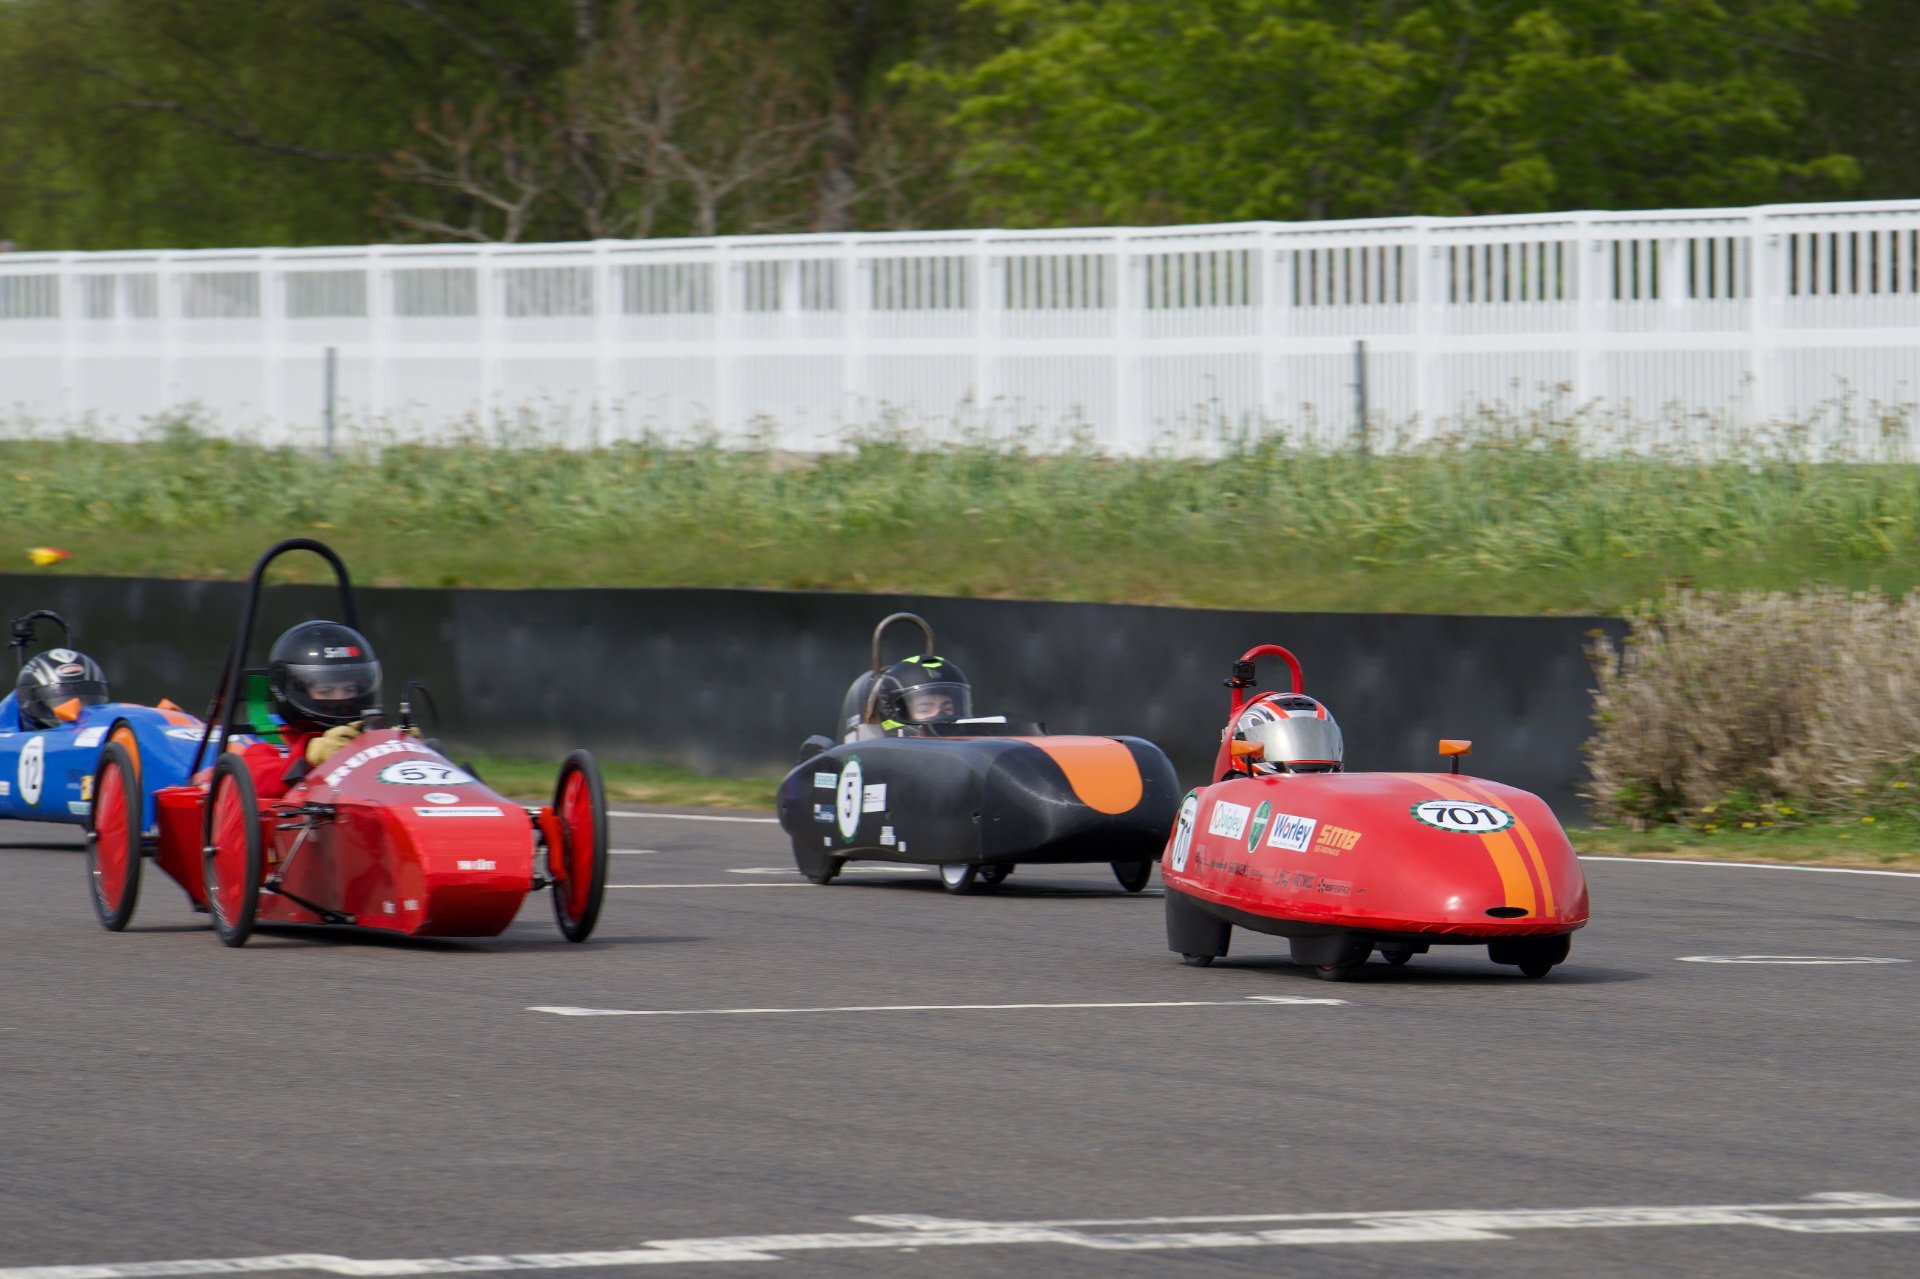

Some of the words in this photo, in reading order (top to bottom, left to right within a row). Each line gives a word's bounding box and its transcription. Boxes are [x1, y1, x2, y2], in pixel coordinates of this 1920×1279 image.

[25, 755, 38, 790] 12
[400, 768, 451, 781] 57
[844, 781, 853, 818] 5
[1273, 814, 1312, 849] Worley
[1422, 807, 1499, 825] 701
[1316, 823, 1362, 851] SMB
